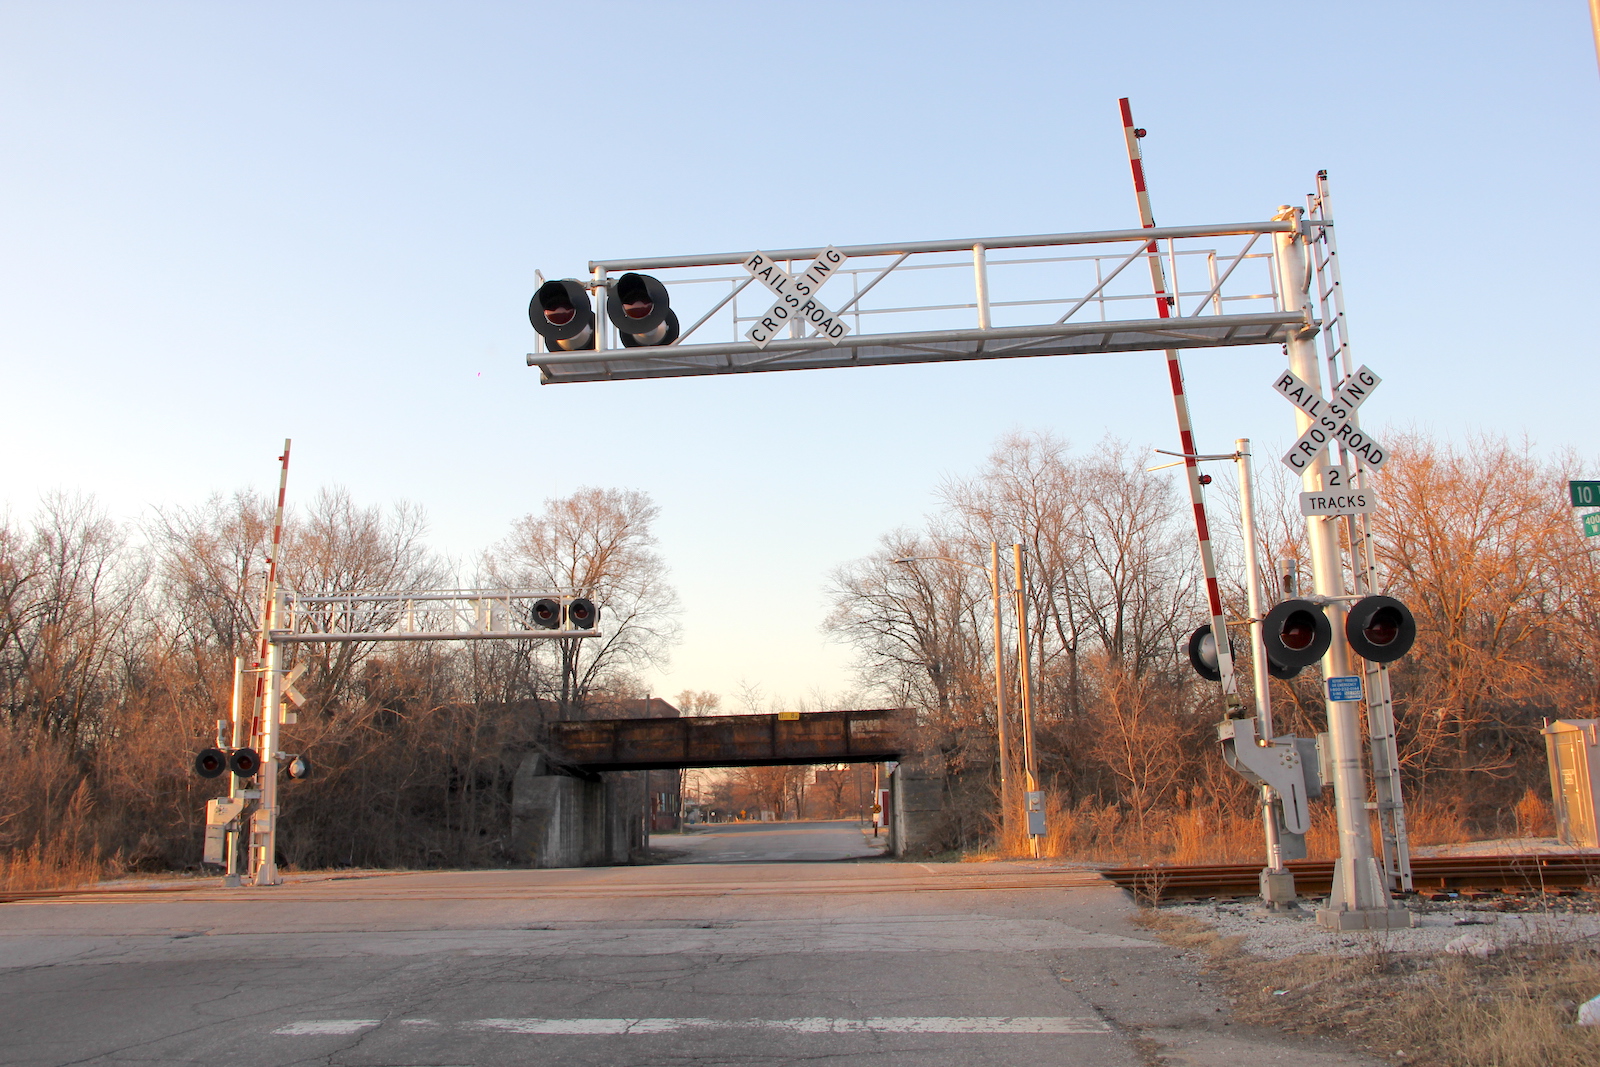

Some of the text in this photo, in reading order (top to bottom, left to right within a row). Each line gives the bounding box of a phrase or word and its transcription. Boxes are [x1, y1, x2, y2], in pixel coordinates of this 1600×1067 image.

[748, 254, 843, 338] RAIL ROAD
[752, 250, 840, 342] CROSSING
[1278, 374, 1383, 465] RAIL ROAD
[1289, 372, 1374, 468] CROSSING
[1309, 495, 1366, 510] TRACKS
[1328, 470, 1341, 486] 2
[1577, 486, 1592, 504] 10
